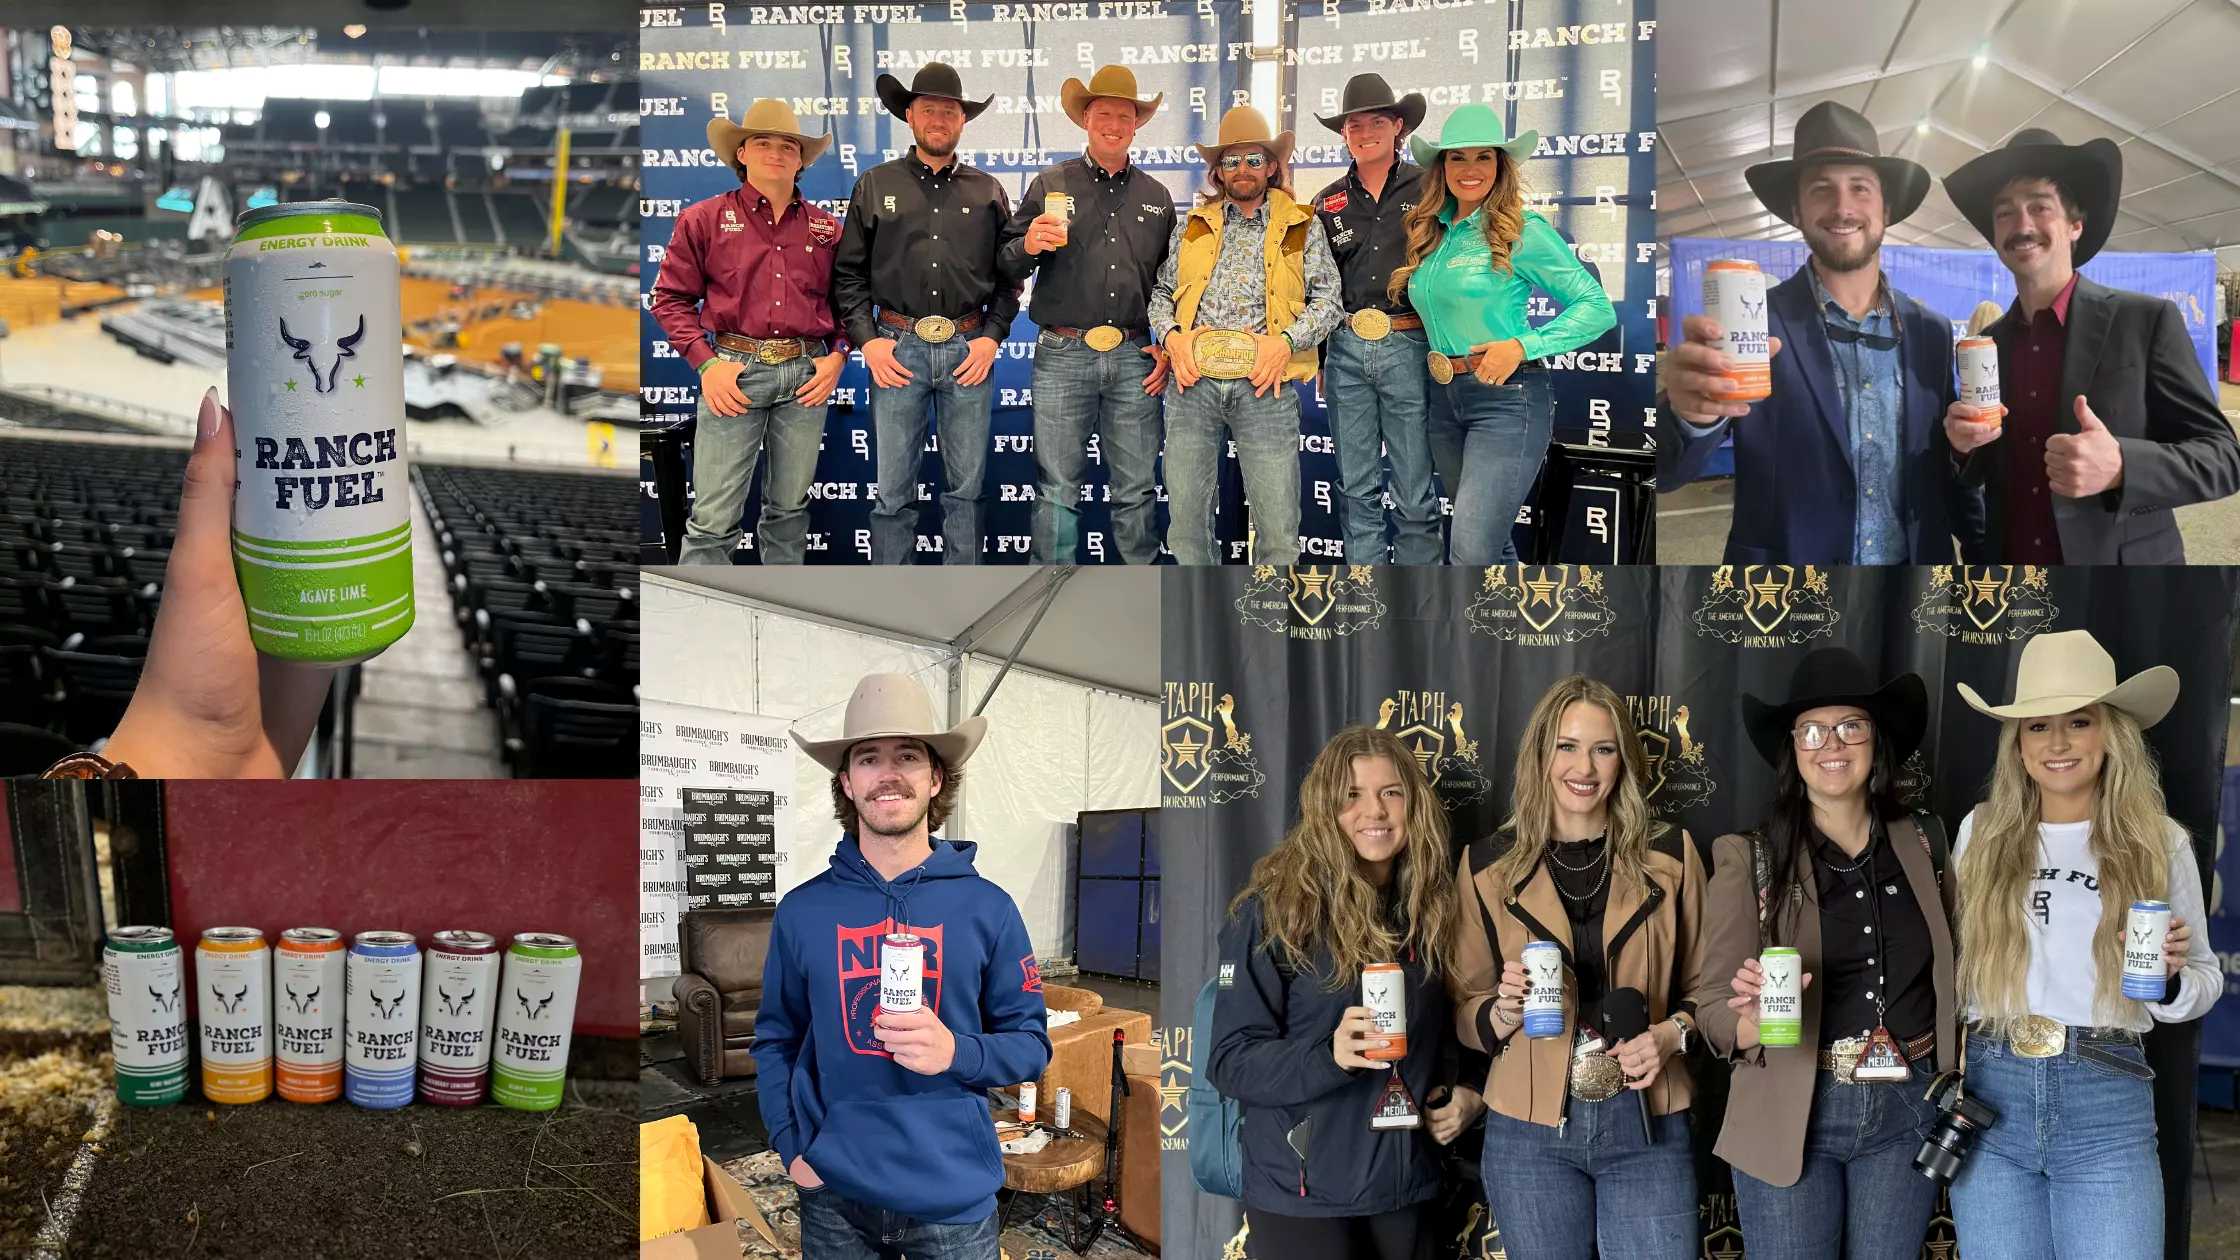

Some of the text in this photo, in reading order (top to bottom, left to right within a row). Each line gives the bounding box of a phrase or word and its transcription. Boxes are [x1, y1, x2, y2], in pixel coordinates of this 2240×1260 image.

[750, 5, 844, 25] RANCH
[993, 3, 1089, 22] RANCH
[1508, 23, 1626, 50] RANCH
[640, 51, 730, 71] RANCH
[877, 50, 972, 68] RANCH
[1121, 43, 1217, 64] RANCH
[1532, 133, 1625, 156] ANCH
[643, 150, 724, 167] RANC
[1129, 147, 1199, 165] RANC
[260, 237, 369, 251] ENERGY DRINK
[255, 428, 397, 470] RANCH
[300, 584, 367, 603] AGAVE LIME
[1290, 626, 1333, 641] HORSEMAN
[1518, 633, 1561, 647] HORSEMAN
[1962, 630, 2003, 646] HORSEMAN
[1744, 635, 1786, 649] HORSEMAN
[1165, 682, 1215, 722] TAPH
[1398, 690, 1445, 730] TAPH
[1626, 696, 1671, 732] TAPH
[675, 724, 729, 743] BRUMBAUGH'S
[740, 732, 788, 750] BRUMBAUGH'S
[641, 753, 759, 776] BRUMBAUGH'S BRUMBAUGH'S
[1211, 772, 1249, 782] PERFORMANCE
[1163, 795, 1207, 809] HORSEMAN
[2126, 950, 2158, 961] RANCH
[2127, 960, 2153, 969] FUEL
[883, 988, 916, 998] RANCH
[886, 996, 912, 1005] FUEL
[1763, 996, 1796, 1005] RANCH
[1767, 1005, 1792, 1013] FUEL
[204, 1024, 262, 1040] RANCH
[278, 1024, 333, 1041] RANCH
[357, 1030, 414, 1046] RANCH
[425, 1025, 484, 1043] RANCH
[502, 1027, 561, 1047] RANCH
[211, 1040, 255, 1054] FUEL
[282, 1039, 324, 1054] FUEL
[363, 1047, 406, 1060] FUEL
[430, 1041, 474, 1057] FUEL
[506, 1044, 550, 1062] FUEL
[1867, 1056, 1895, 1067] MEDIA
[1383, 1106, 1408, 1116] MEDIA
